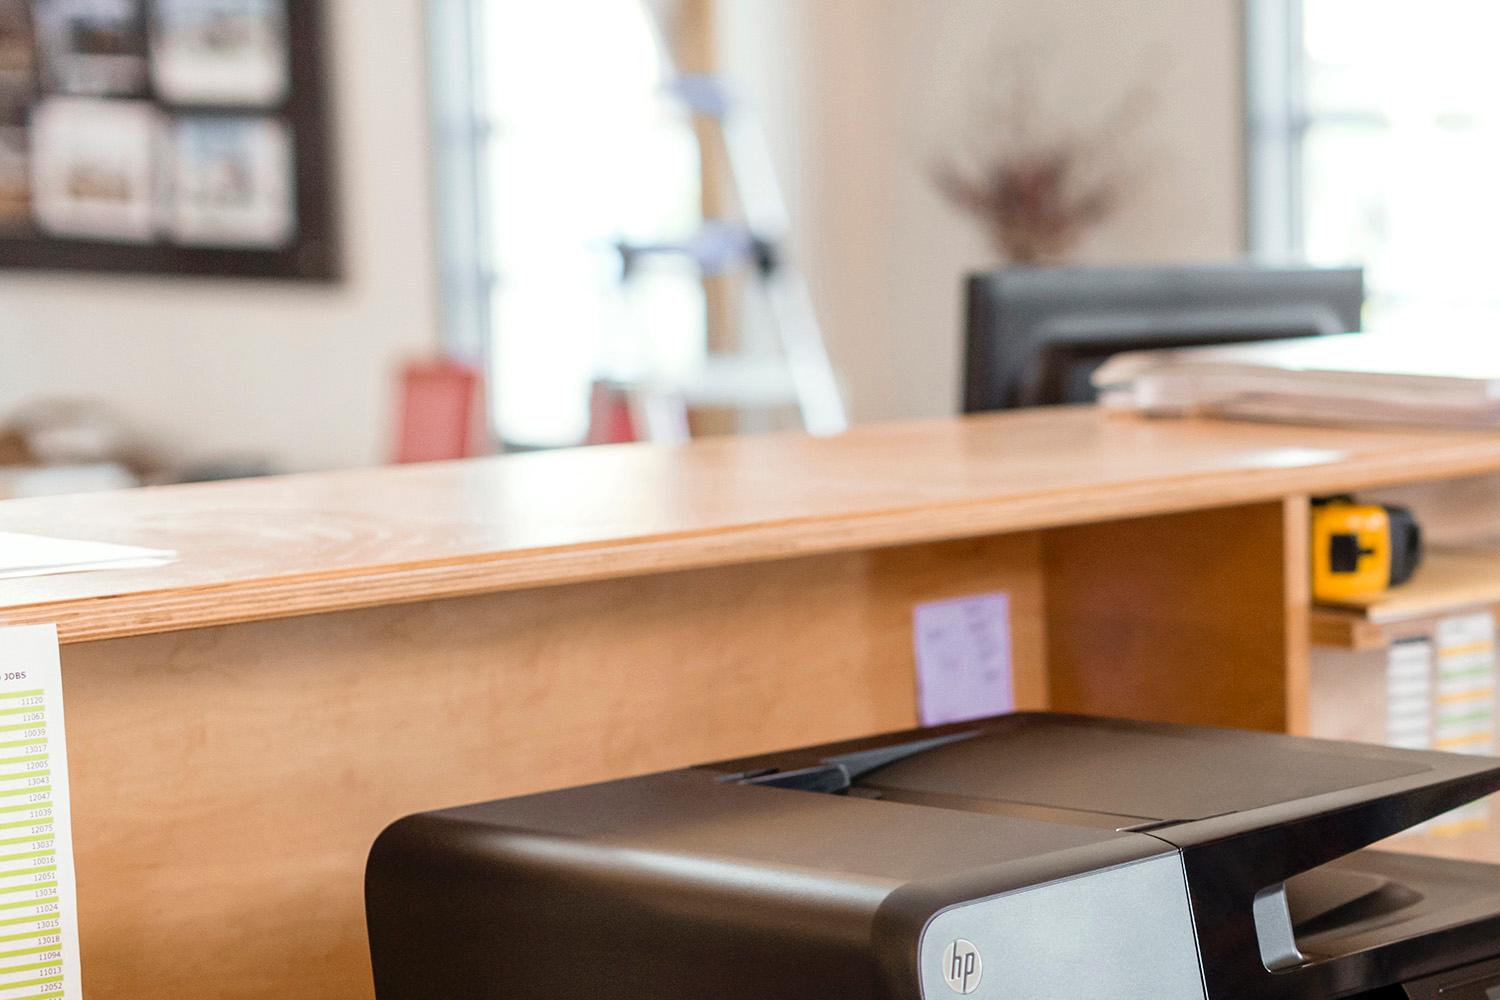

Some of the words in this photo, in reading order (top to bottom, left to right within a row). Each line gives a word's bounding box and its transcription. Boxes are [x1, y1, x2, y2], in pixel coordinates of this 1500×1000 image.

[4, 672, 26, 681] JOBS
[22, 697, 43, 705] 11120
[24, 729, 46, 737] 10039
[25, 745, 47, 754] 13017
[27, 760, 48, 770] 12005
[28, 777, 49, 786] 13043
[29, 792, 51, 802] 12047
[30, 809, 52, 818] 11039
[31, 824, 53, 834] 12075
[32, 841, 54, 850] 13037
[33, 856, 55, 866] 10016
[34, 872, 55, 882] 12051
[35, 888, 57, 897] 13034
[36, 904, 58, 913] 11024
[37, 920, 59, 929] 13015
[38, 936, 60, 945] 13018
[39, 952, 61, 960] 11094
[949, 938, 976, 993] hp
[40, 967, 61, 977] 11013
[40, 983, 62, 992] 12052
